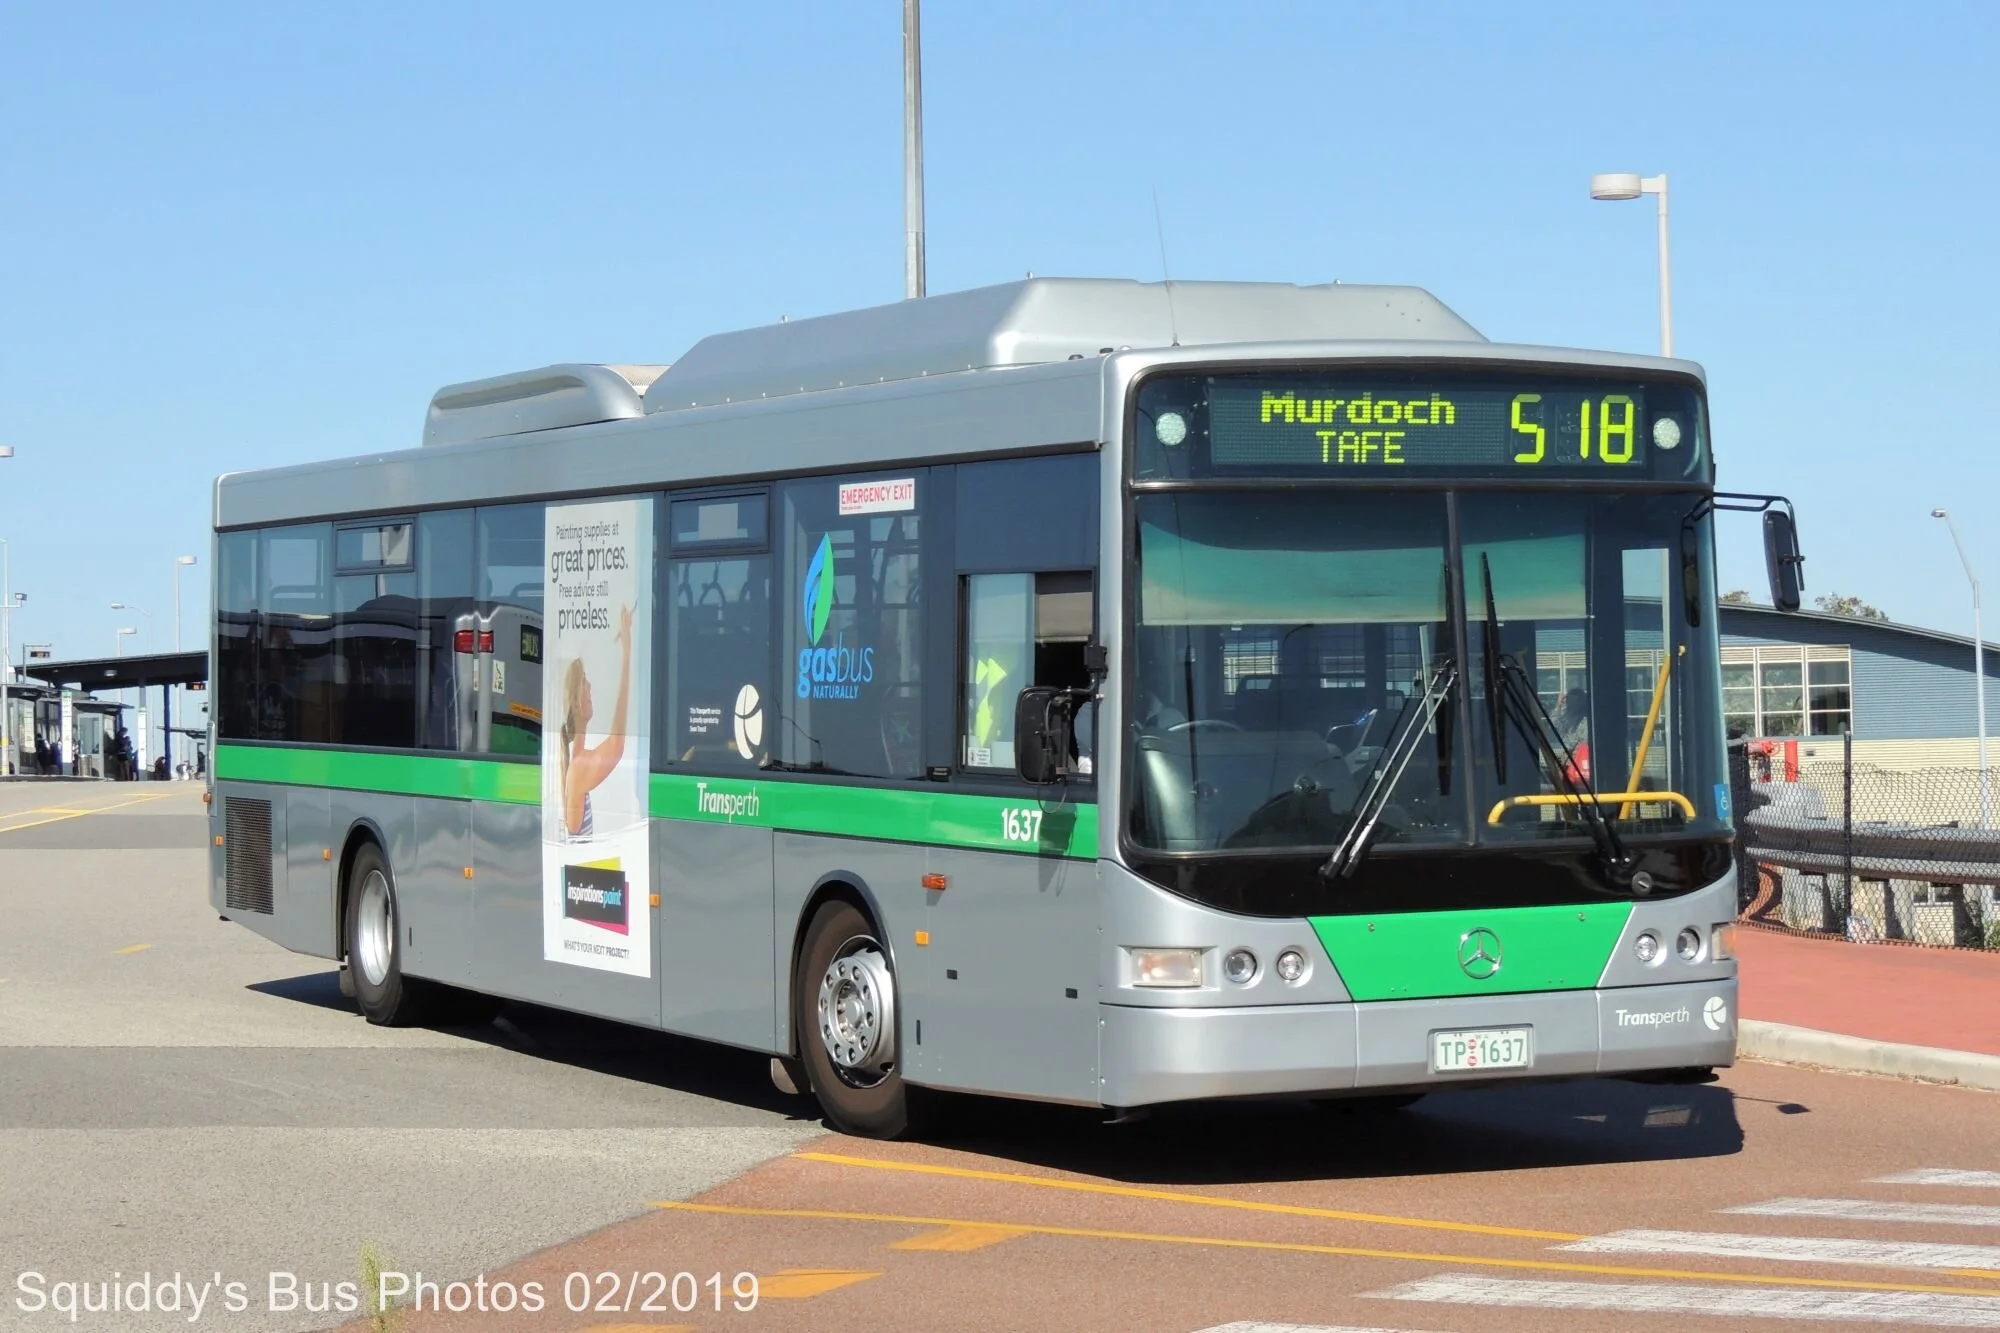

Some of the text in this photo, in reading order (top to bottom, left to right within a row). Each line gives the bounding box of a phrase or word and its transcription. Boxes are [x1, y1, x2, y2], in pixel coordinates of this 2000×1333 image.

[1261, 391, 1455, 424] Murdoch
[1316, 431, 1405, 463] TAFE
[841, 483, 913, 505] EMERGENCY EXIT
[556, 520, 619, 541] Painting supplies at
[551, 540, 628, 583] great prices.
[559, 580, 609, 598] Free advice still
[558, 601, 610, 638] priceless.
[813, 685, 858, 699] NATURALLY
[697, 782, 760, 823] Transperth
[1001, 808, 1043, 843] 1637
[593, 944, 605, 956] NEXT
[1616, 1006, 1690, 1028] Transperth
